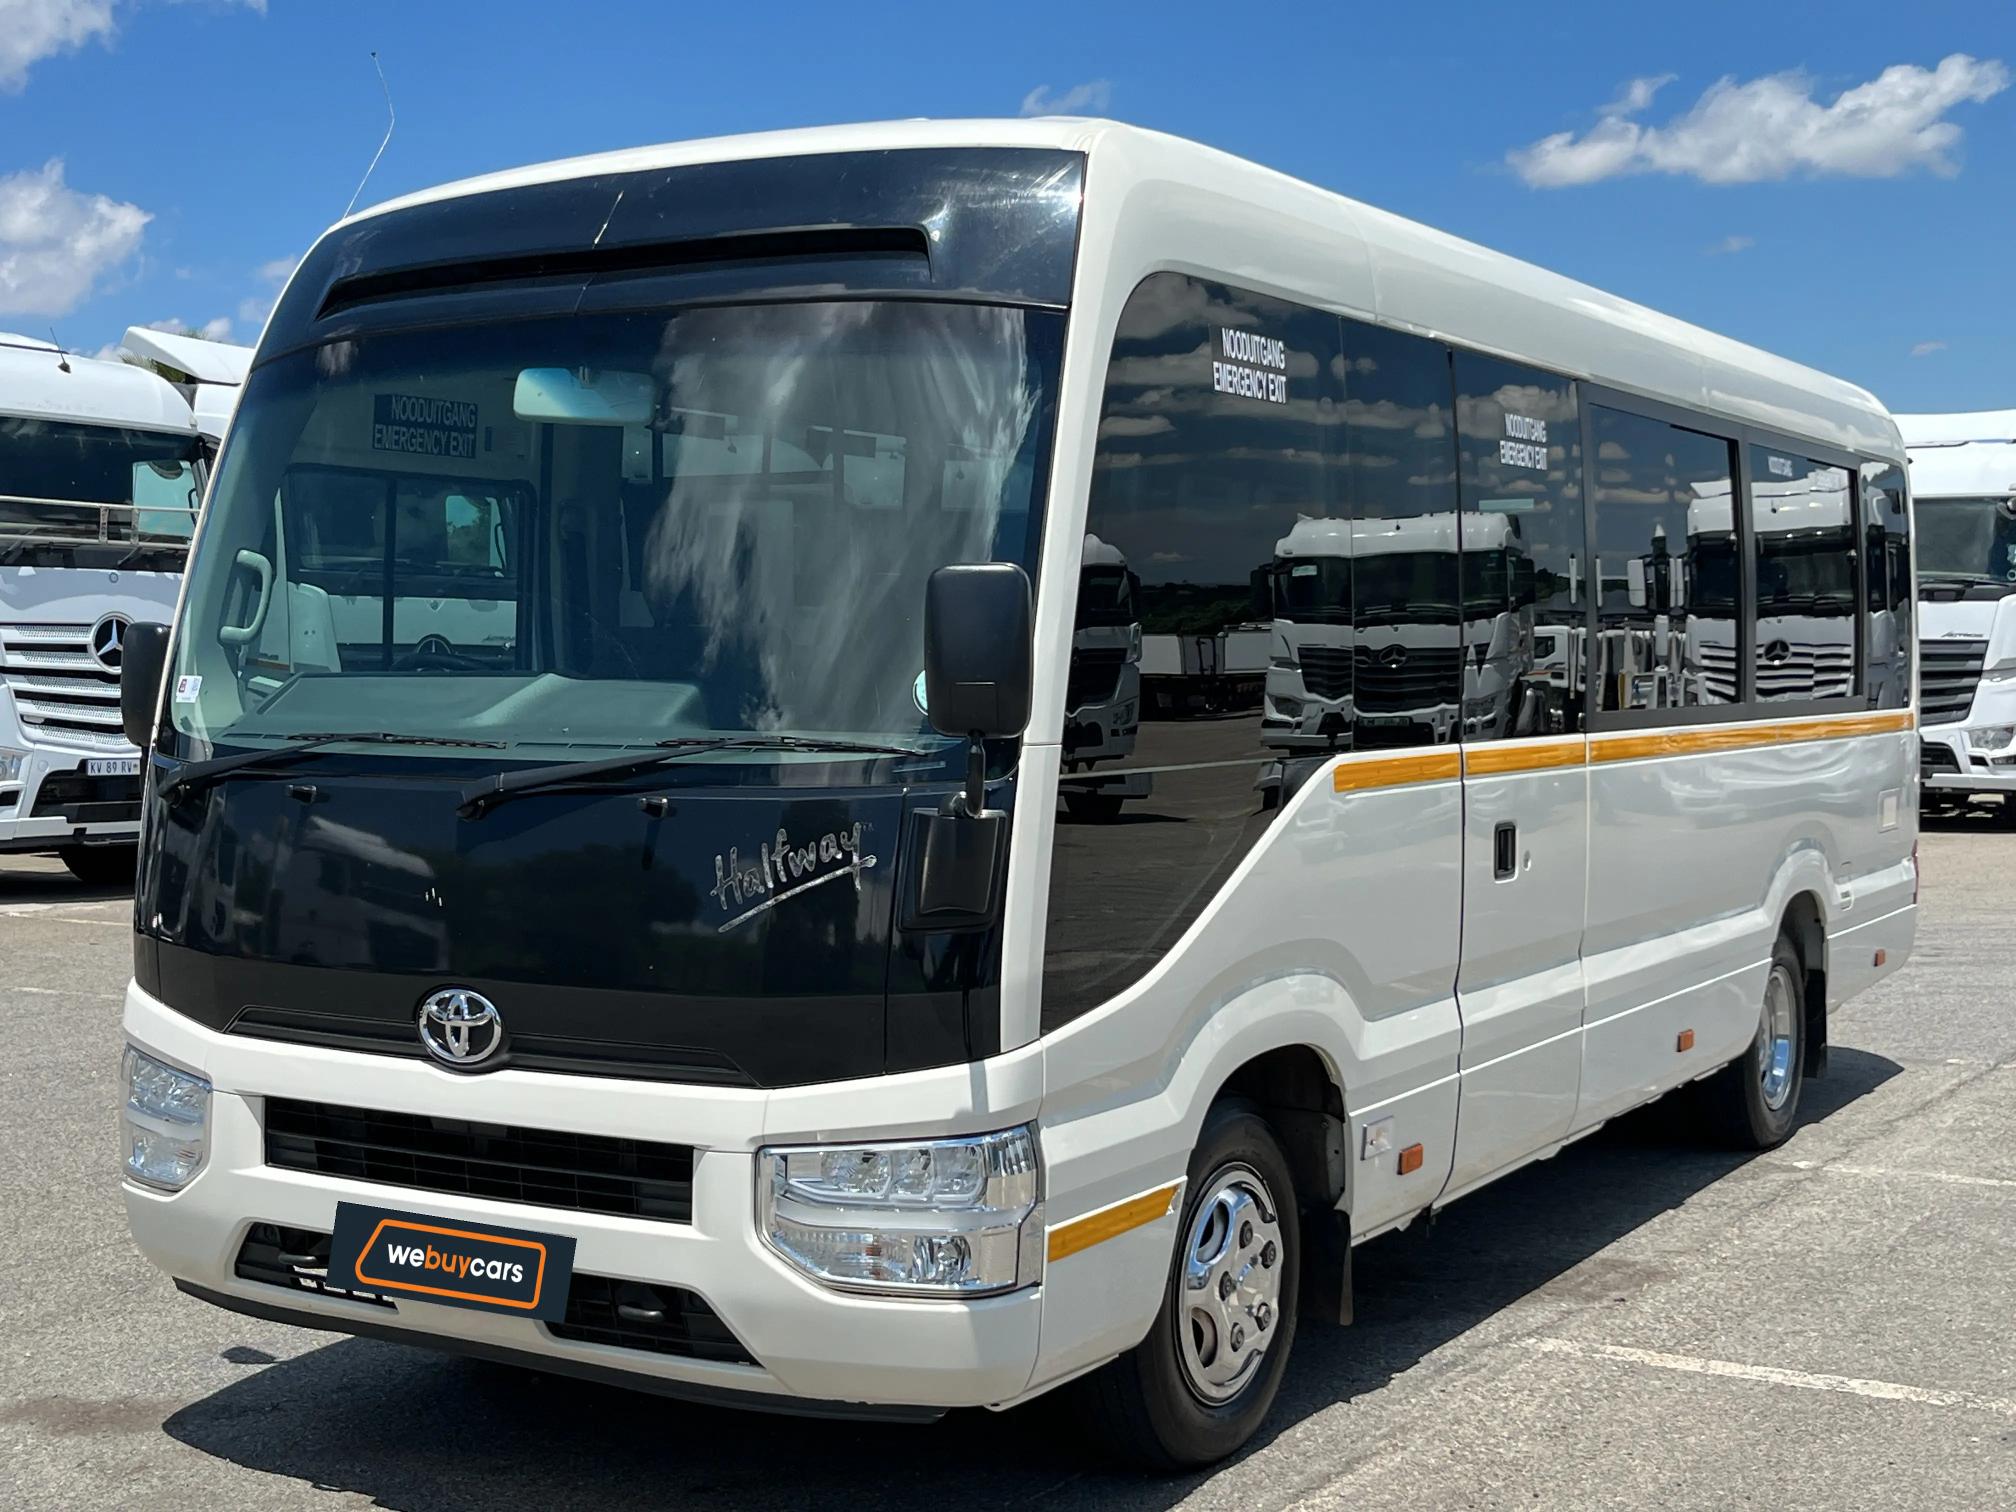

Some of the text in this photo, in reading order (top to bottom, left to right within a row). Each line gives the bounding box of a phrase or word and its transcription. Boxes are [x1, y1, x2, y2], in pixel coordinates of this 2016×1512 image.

[1222, 327, 1285, 370] NOODUITGANG
[1213, 361, 1287, 404] EMERGENCY EXIT
[391, 395, 477, 428] NOODUITGANG
[374, 424, 474, 457] EMERGENCY EXIT
[106, 761, 118, 774] 89
[709, 821, 863, 911] Halfway
